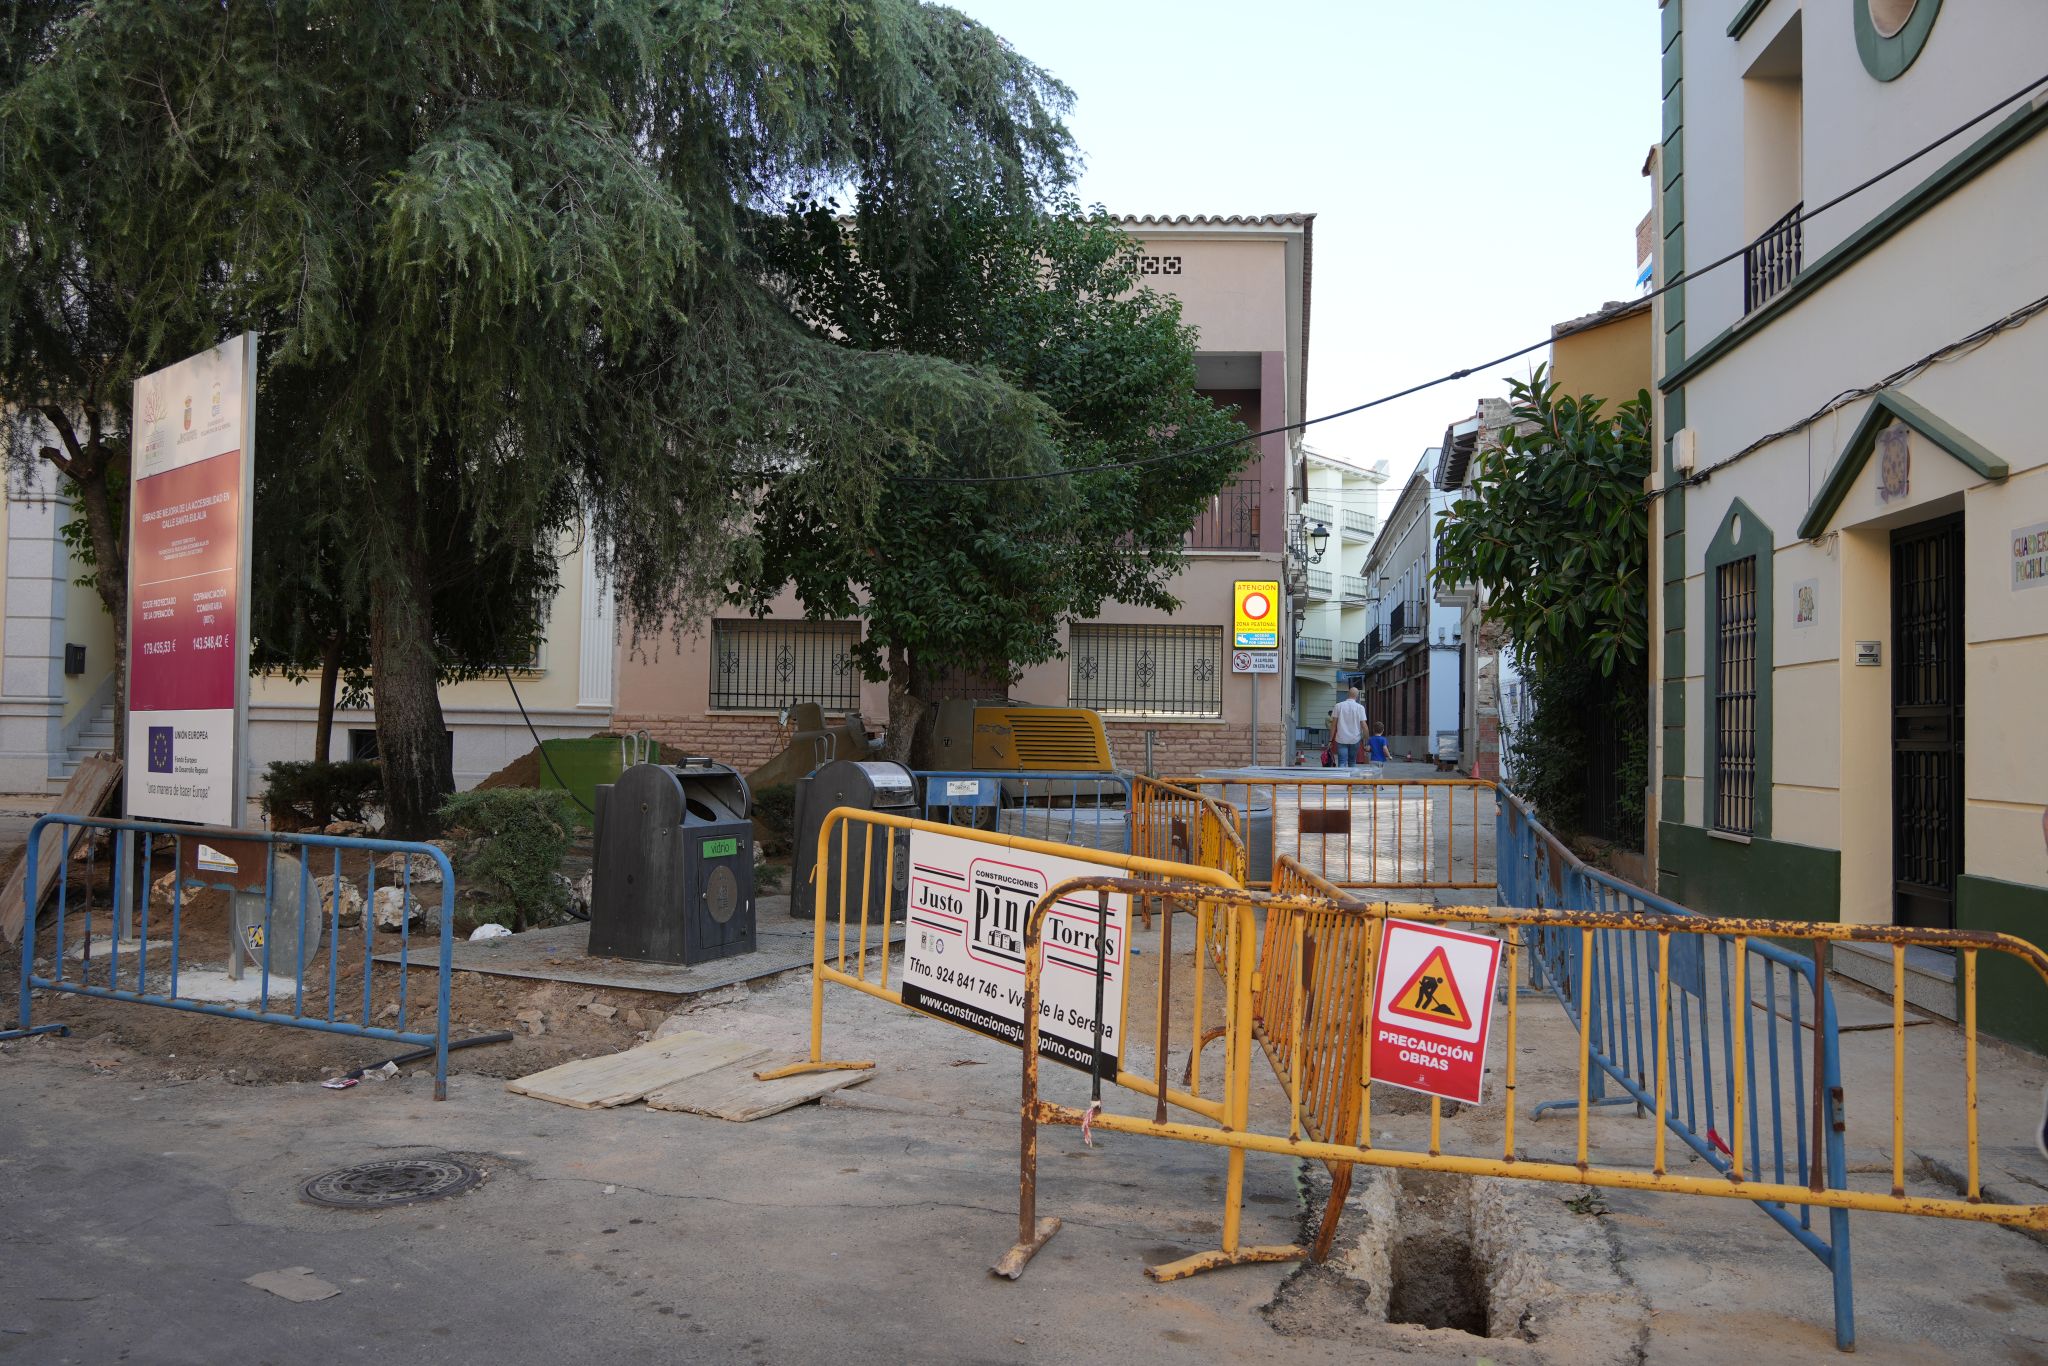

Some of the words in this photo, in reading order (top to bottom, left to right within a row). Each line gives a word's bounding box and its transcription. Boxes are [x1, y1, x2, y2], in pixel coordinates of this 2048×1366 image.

[188, 730, 208, 740] EUROPEA
[711, 842, 729, 854] vidrio
[975, 869, 1039, 890] CONSTRUCCIONES
[919, 885, 963, 915] Justo
[910, 956, 933, 978] Tfno.
[936, 966, 954, 985] 924
[956, 971, 975, 992] 841
[978, 978, 998, 1000] 746
[1038, 1000, 1051, 1017] de
[1053, 1003, 1064, 1022] la
[920, 992, 1093, 1066] www.construccionesjupino.com
[1378, 1030, 1474, 1063] PRECAUCIÓN
[1399, 1050, 1449, 1071] OBRAS
